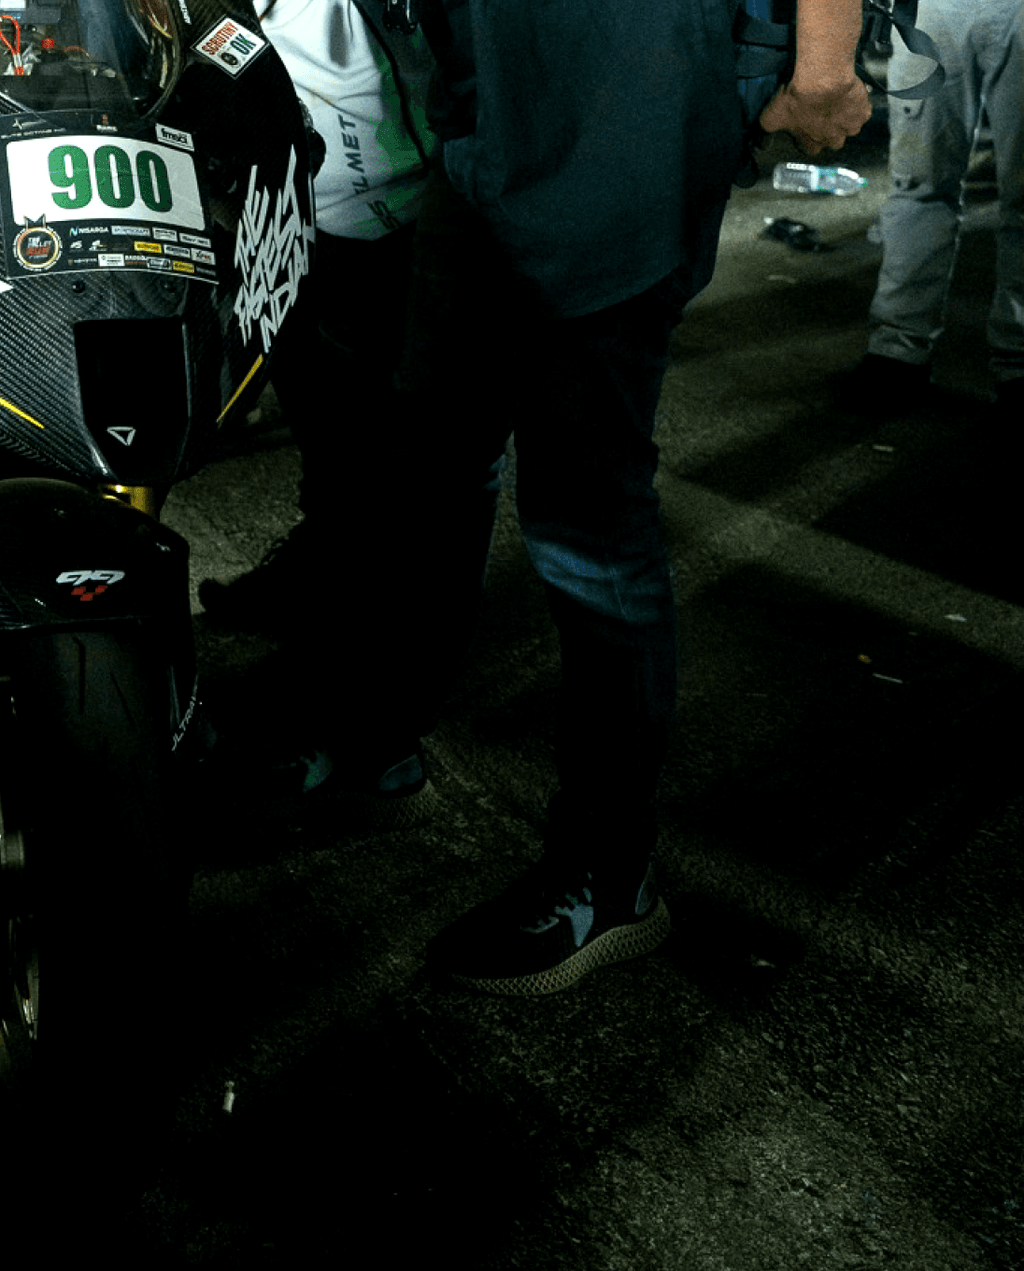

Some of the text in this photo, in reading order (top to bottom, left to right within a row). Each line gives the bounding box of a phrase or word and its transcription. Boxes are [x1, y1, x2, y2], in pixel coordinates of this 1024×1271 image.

[230, 33, 257, 55] OK
[47, 144, 173, 213] 900
[338, 113, 370, 195] ELMET
